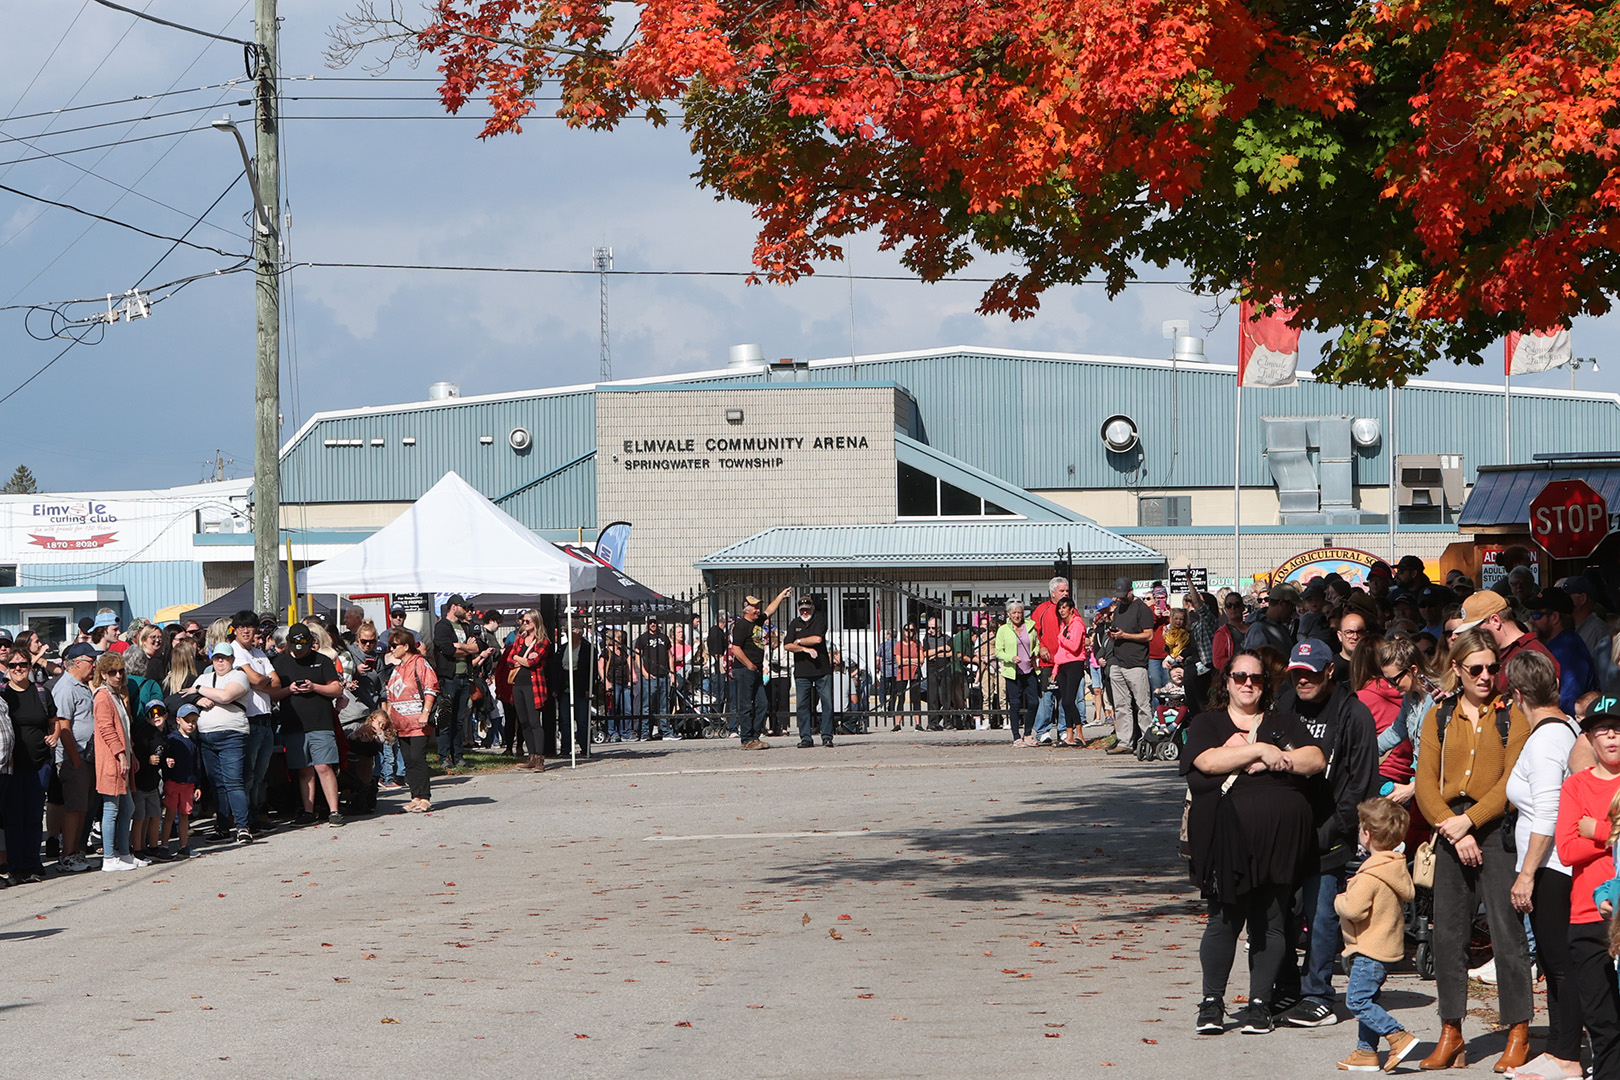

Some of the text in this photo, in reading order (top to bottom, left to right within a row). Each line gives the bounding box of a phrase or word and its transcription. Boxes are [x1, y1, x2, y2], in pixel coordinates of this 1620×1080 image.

[623, 436, 868, 453] ELMVALE COMMUNITY ARENA
[624, 457, 783, 470] SPRINGWATER TOWNSHIP
[50, 514, 117, 524] curling club
[1536, 503, 1603, 535] STOP
[1290, 549, 1362, 570] AGRICULTURAL
